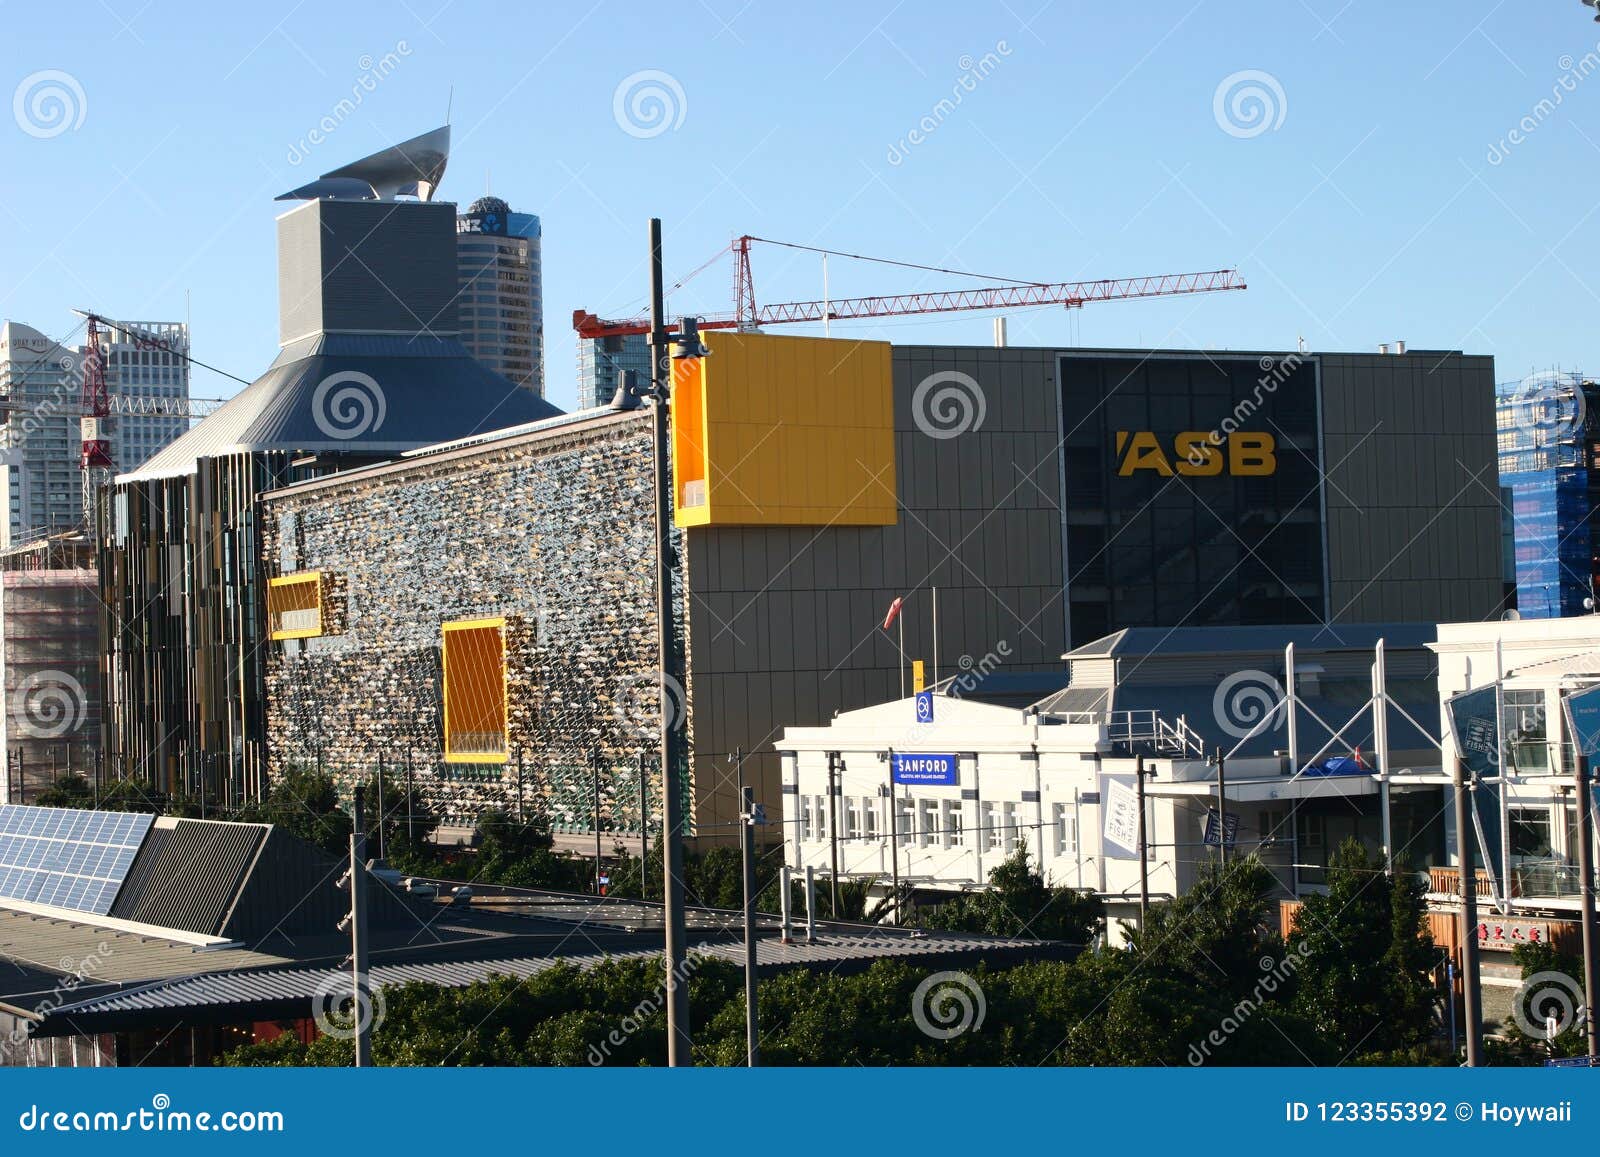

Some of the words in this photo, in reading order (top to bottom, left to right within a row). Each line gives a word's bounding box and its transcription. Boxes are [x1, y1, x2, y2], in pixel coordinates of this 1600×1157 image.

[1116, 431, 1277, 477] ASB
[898, 759, 948, 773] SANFORD
[1109, 822, 1126, 838] FISH
